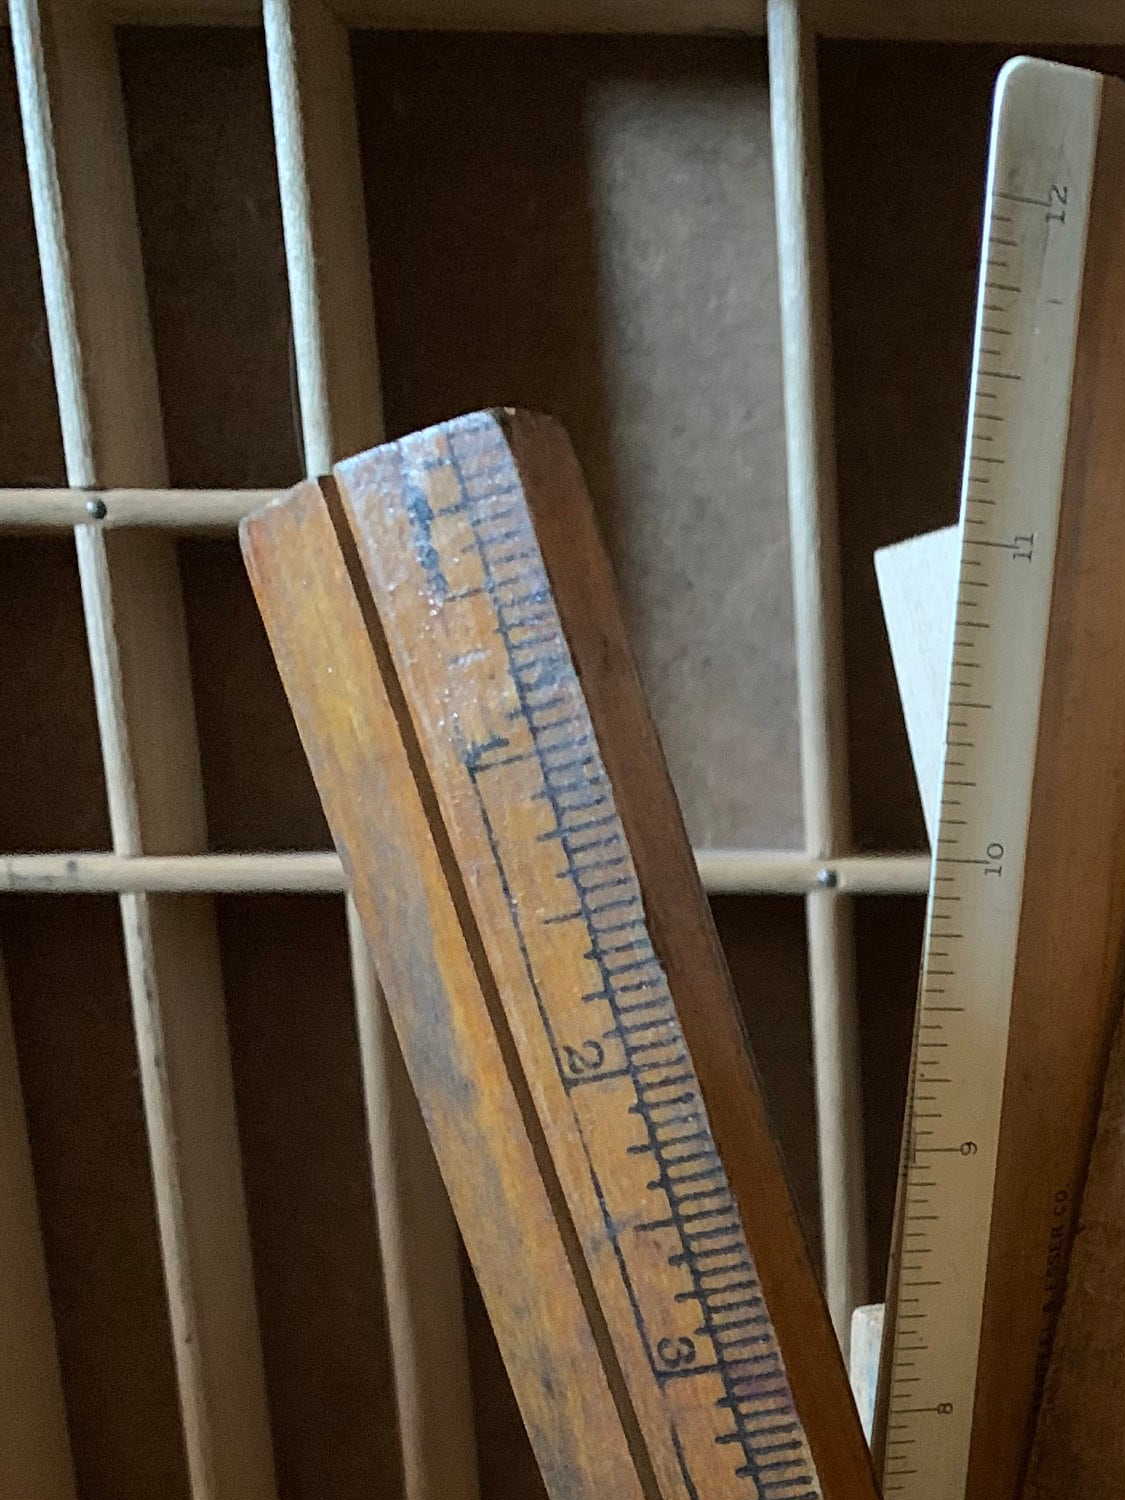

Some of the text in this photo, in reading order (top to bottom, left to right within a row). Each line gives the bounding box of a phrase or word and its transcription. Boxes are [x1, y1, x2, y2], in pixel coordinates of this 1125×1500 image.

[1046, 184, 1068, 224] 12
[1013, 532, 1035, 561] 11
[466, 735, 510, 766] 1
[984, 842, 1005, 877] 10
[562, 1040, 605, 1074] 2
[959, 1140, 979, 1157] 9
[657, 1336, 696, 1369] 3
[936, 1402, 954, 1415] 8
